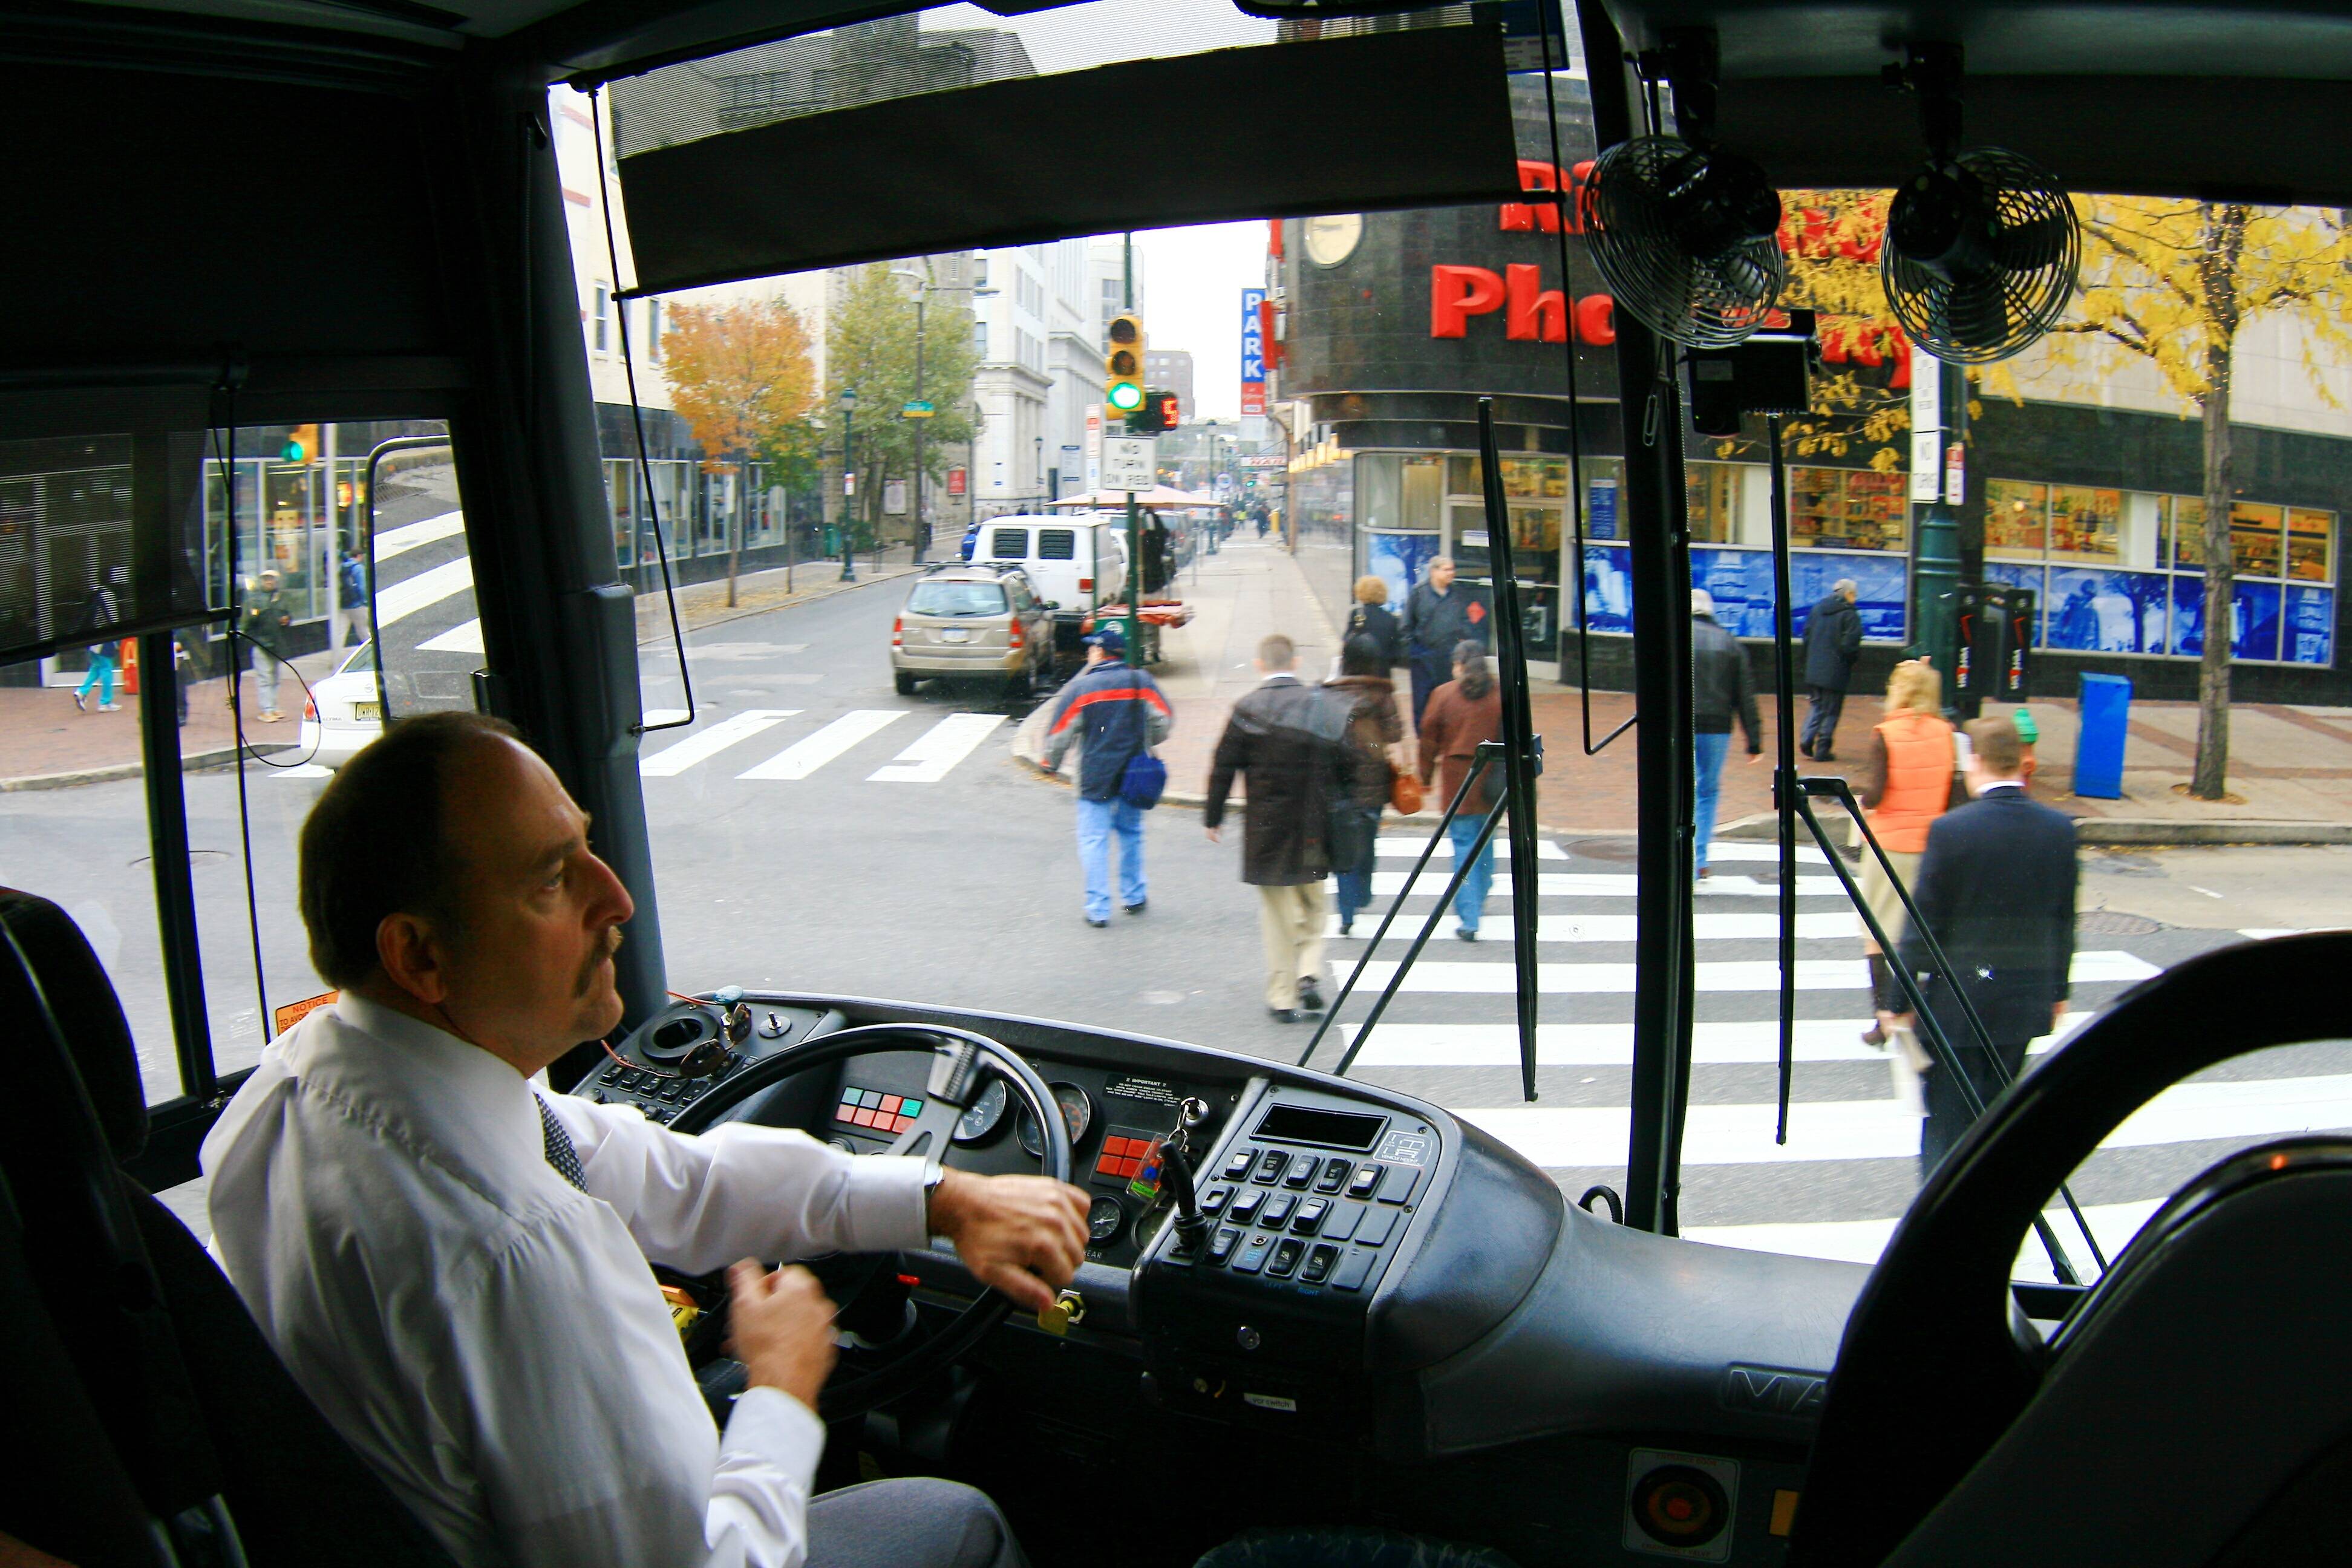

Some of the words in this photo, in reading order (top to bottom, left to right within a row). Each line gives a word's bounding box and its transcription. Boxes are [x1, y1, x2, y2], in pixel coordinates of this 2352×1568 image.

[1244, 293, 1264, 378] PARK
[1161, 397, 1179, 427] 5
[1120, 442, 1140, 454] NO
[1112, 459, 1145, 470] TURN
[1105, 474, 1120, 483] ON
[1126, 475, 1148, 485] RED
[292, 996, 328, 1013] NOTICE
[1131, 1078, 1161, 1086] IMPORTANT
